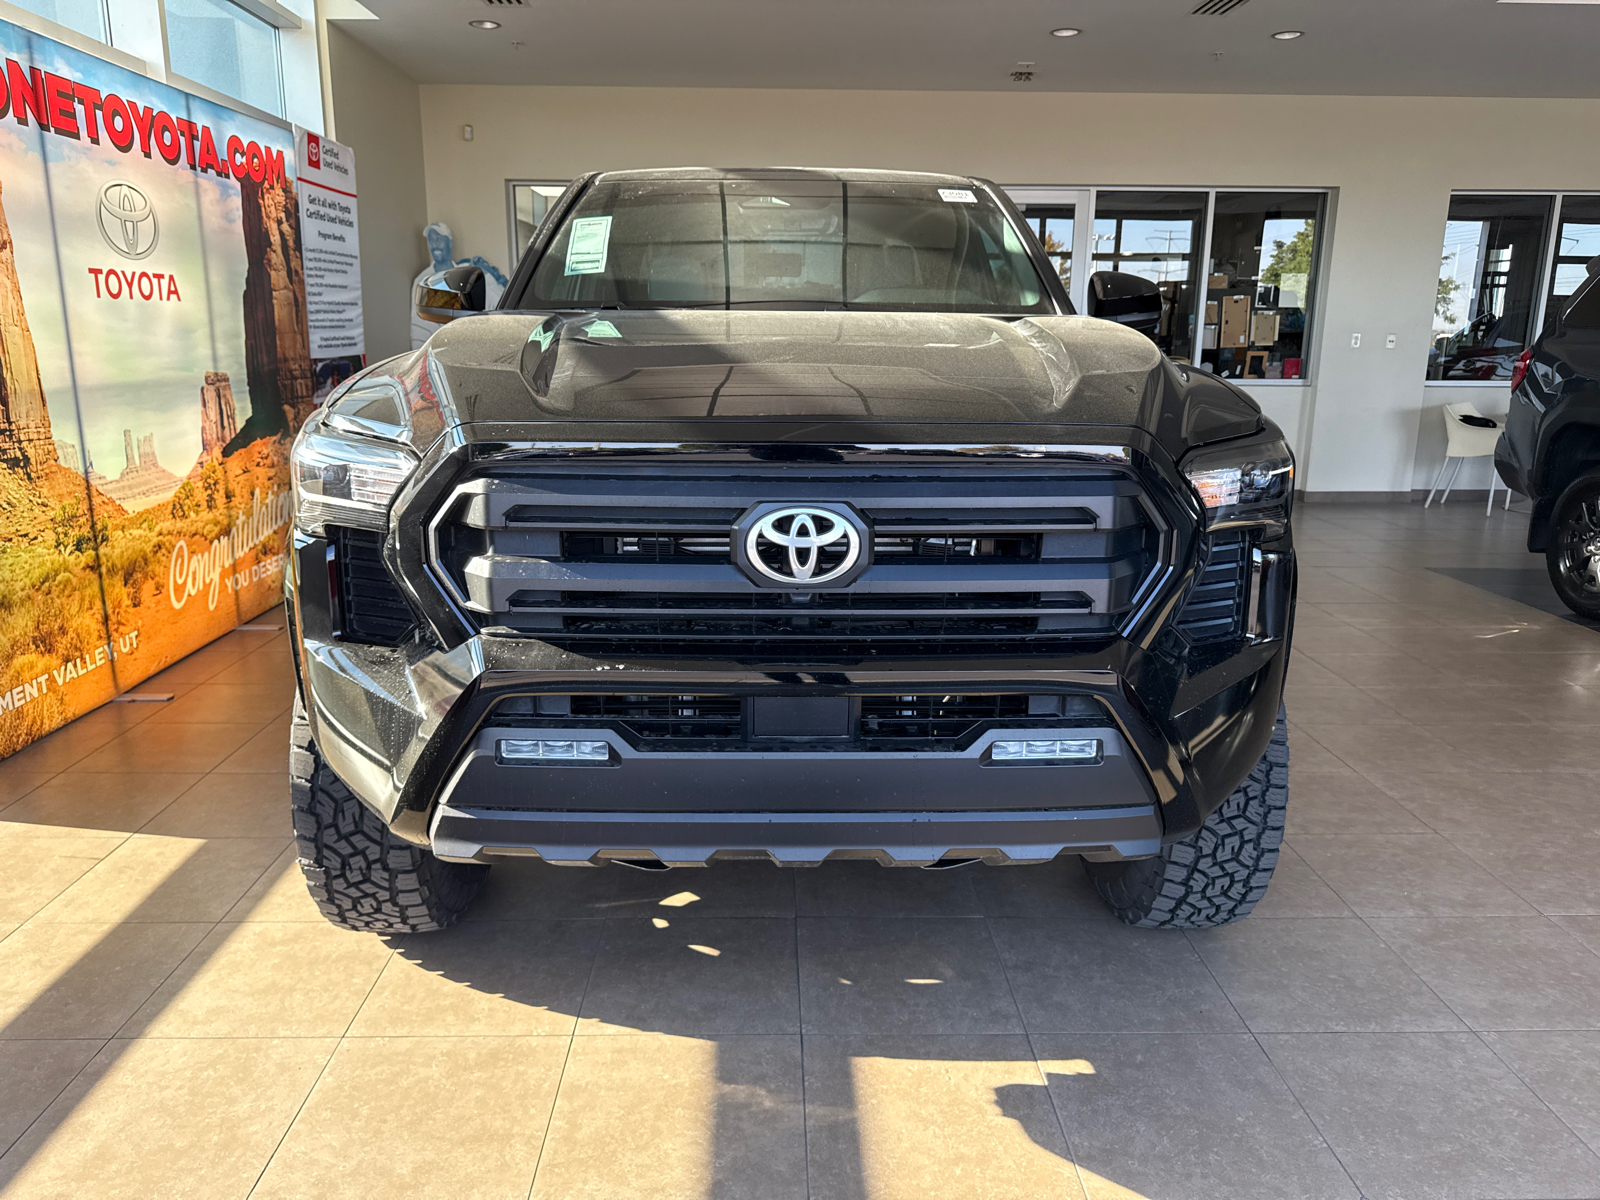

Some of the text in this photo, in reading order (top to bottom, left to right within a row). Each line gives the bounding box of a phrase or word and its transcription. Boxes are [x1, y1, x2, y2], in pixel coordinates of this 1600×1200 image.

[322, 144, 340, 160] Certified
[322, 157, 349, 176] Used Vehicles
[308, 194, 318, 206] Get
[328, 200, 337, 211] with
[337, 202, 351, 215] Toyota
[306, 208, 354, 229] Certified Used Vehicles
[88, 267, 182, 302] TOYOTA
[225, 569, 250, 594] YOU
[52, 641, 118, 687] VALLEY,
[119, 630, 139, 654] UT
